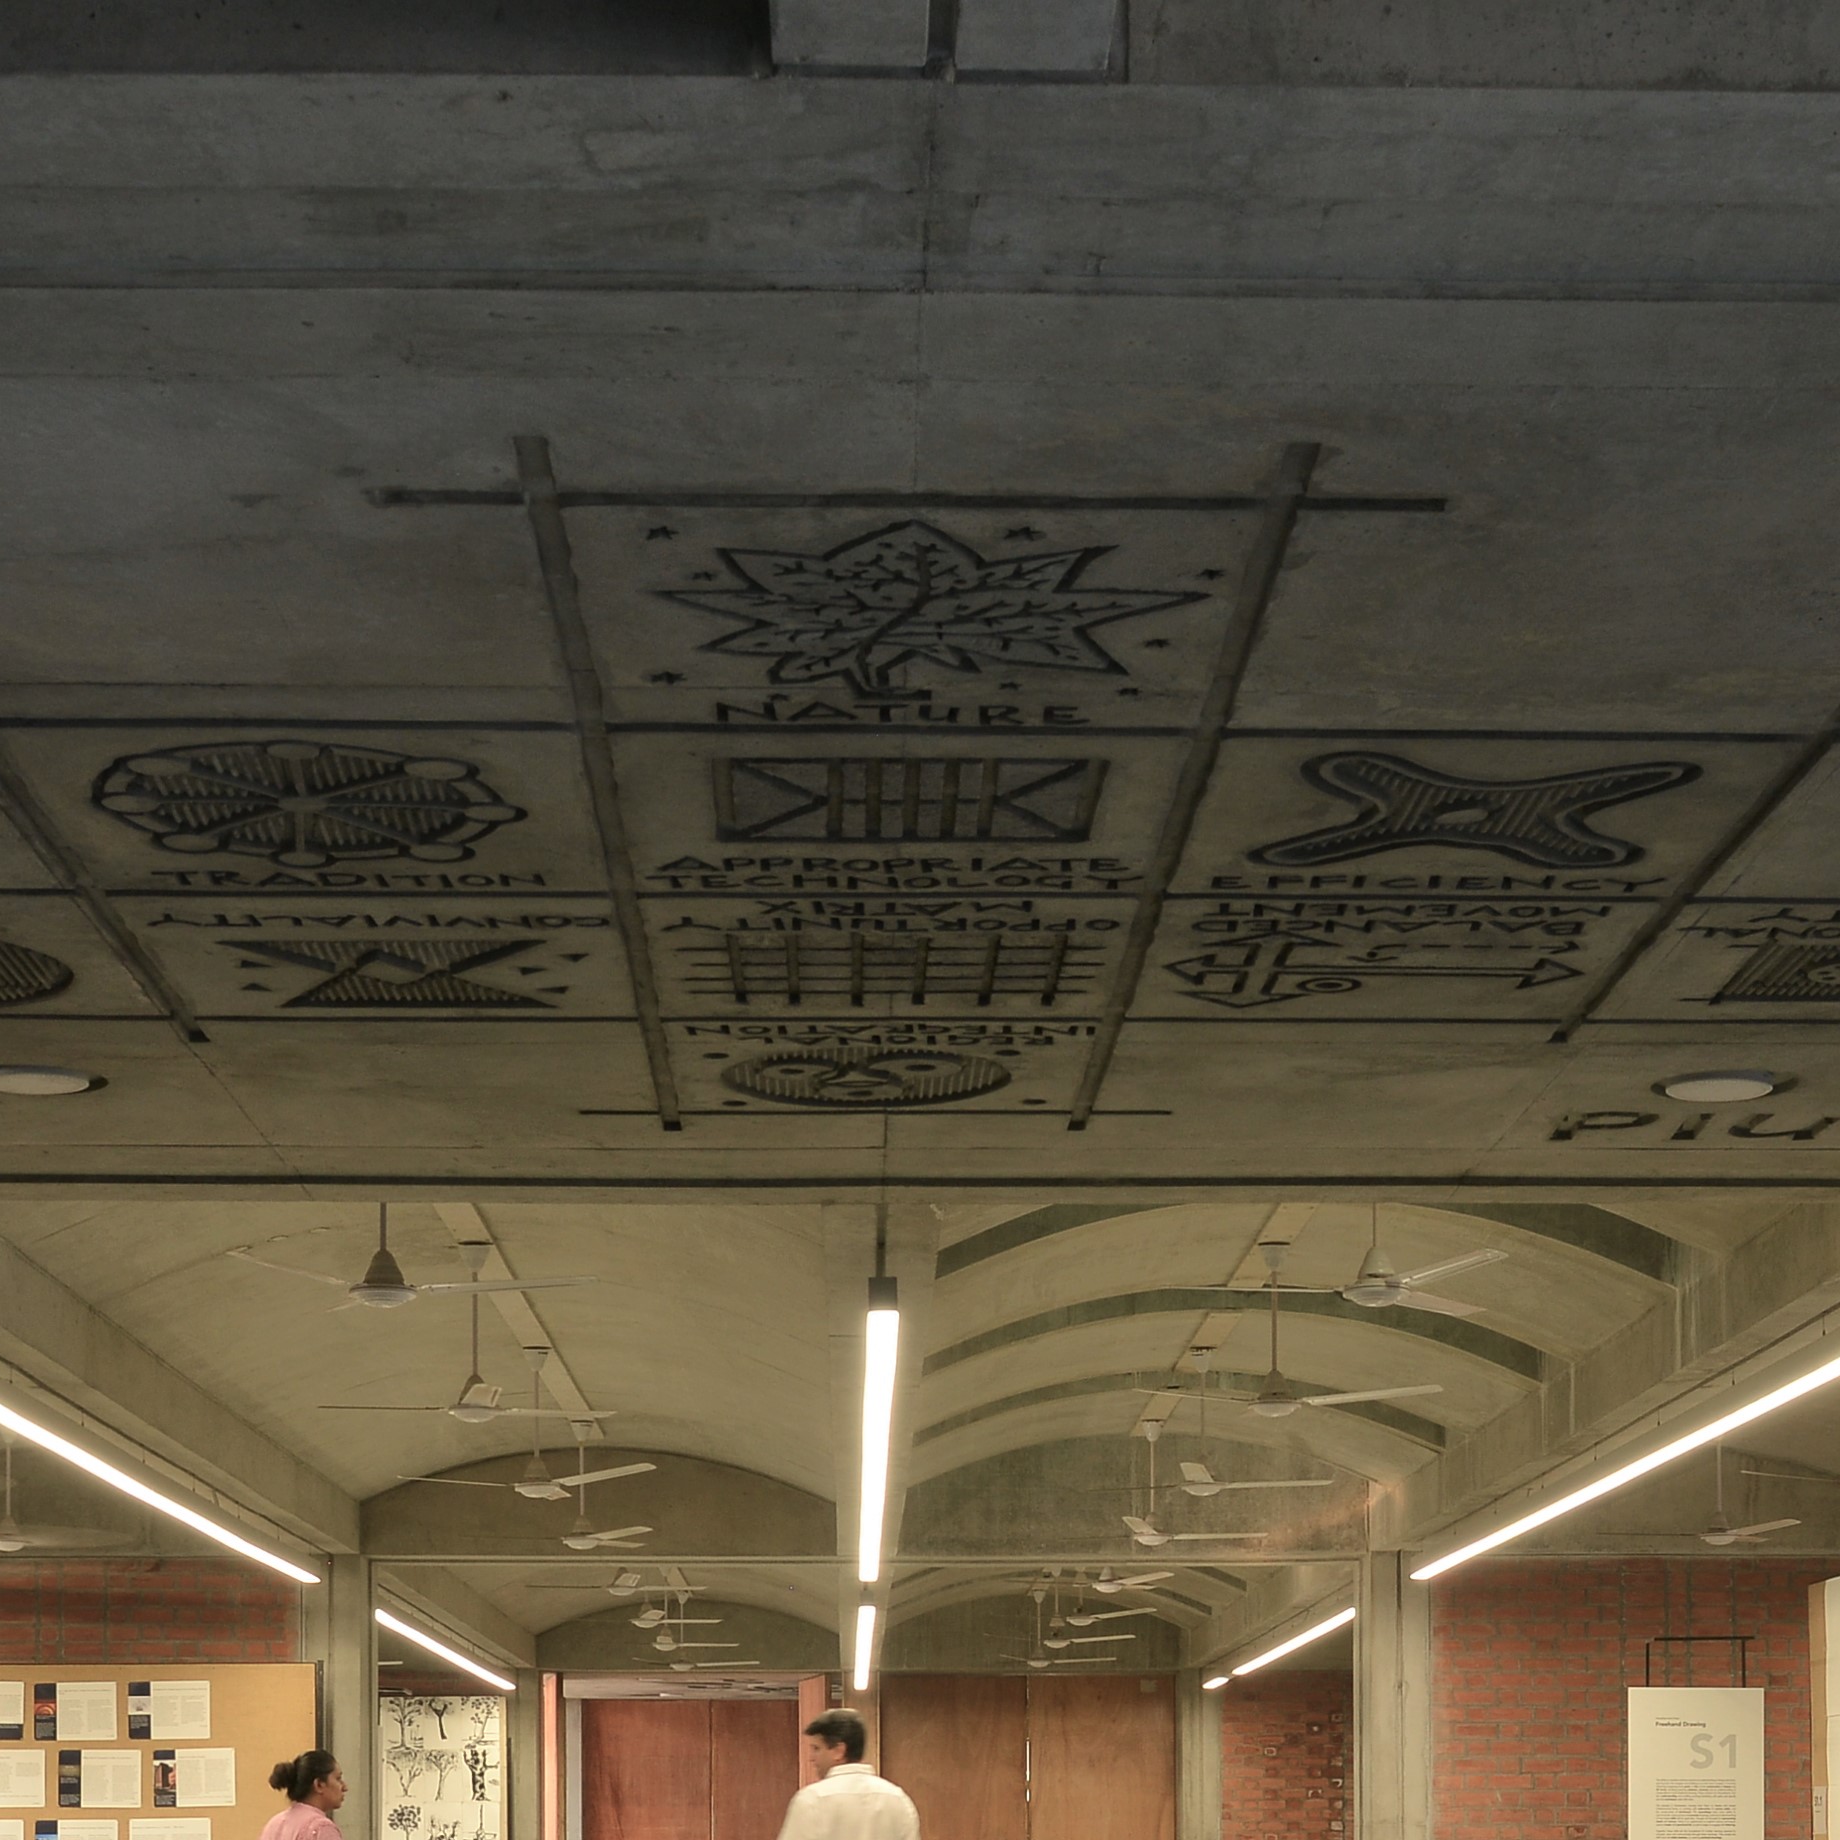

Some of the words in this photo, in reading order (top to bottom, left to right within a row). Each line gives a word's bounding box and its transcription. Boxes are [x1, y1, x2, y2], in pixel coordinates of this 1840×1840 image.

[716, 700, 1090, 725] NATURE
[656, 855, 1131, 873] APPROPRIATE
[150, 870, 547, 888] TRADITION
[646, 874, 1144, 890] TECHNOLOGY
[1210, 874, 1666, 893] EFFICIENCY
[757, 900, 1034, 916] MATRIX
[1203, 902, 1611, 917] MOVEMENT
[146, 912, 615, 929] CONVIVIALITY
[660, 916, 1122, 932] OPPORTUNITY
[1190, 919, 1586, 936] BALANCED
[685, 1024, 1097, 1036] INTEGRATION
[750, 1035, 1054, 1046] REGIONAL
[1689, 1733, 1737, 1769] S1
